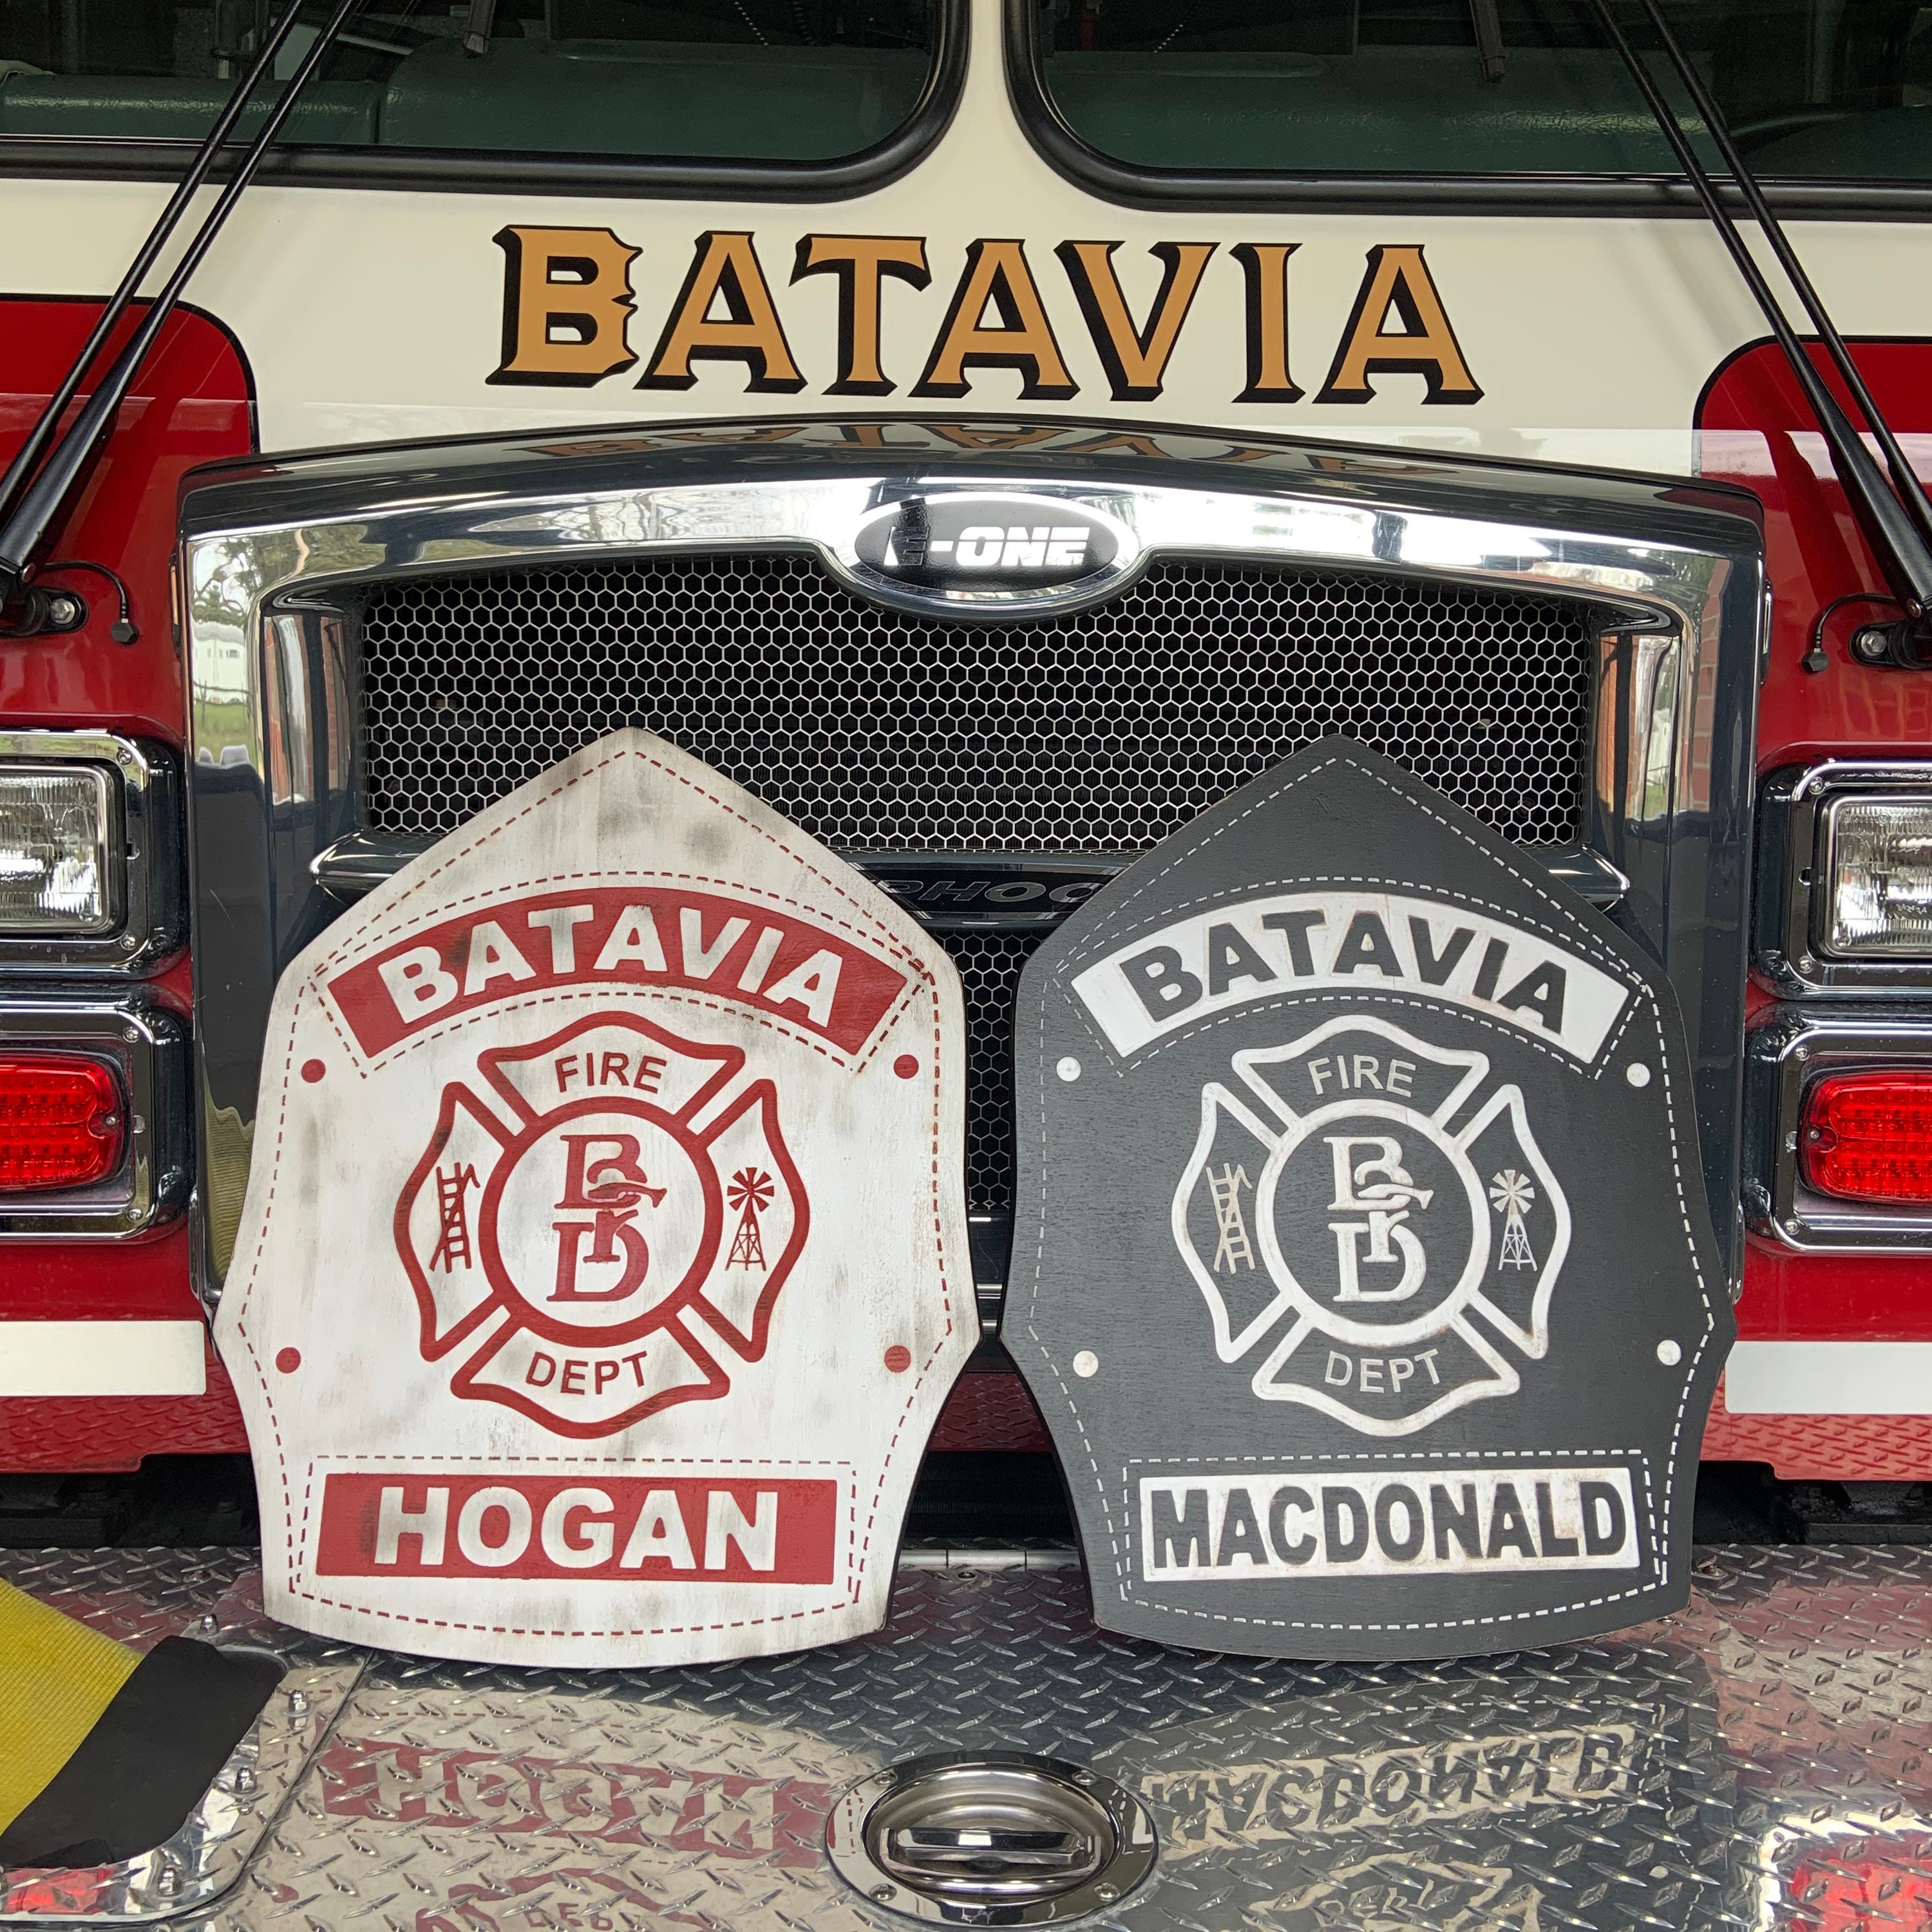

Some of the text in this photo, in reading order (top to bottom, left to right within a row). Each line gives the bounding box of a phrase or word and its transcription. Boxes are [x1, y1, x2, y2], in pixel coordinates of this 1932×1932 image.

[485, 224, 1485, 404] BATAVIA
[884, 526, 1090, 566] E-ONE
[377, 904, 843, 1028] BATAVIA
[1119, 909, 1567, 1035] BATAVIA
[554, 1052, 667, 1094] FIRE
[1307, 1054, 1416, 1097] FIRE
[525, 1350, 648, 1395] DEPT
[1324, 1349, 1441, 1393] DEPT
[374, 1486, 778, 1571] HOGAN
[1151, 1481, 1627, 1569] MACDONALD
